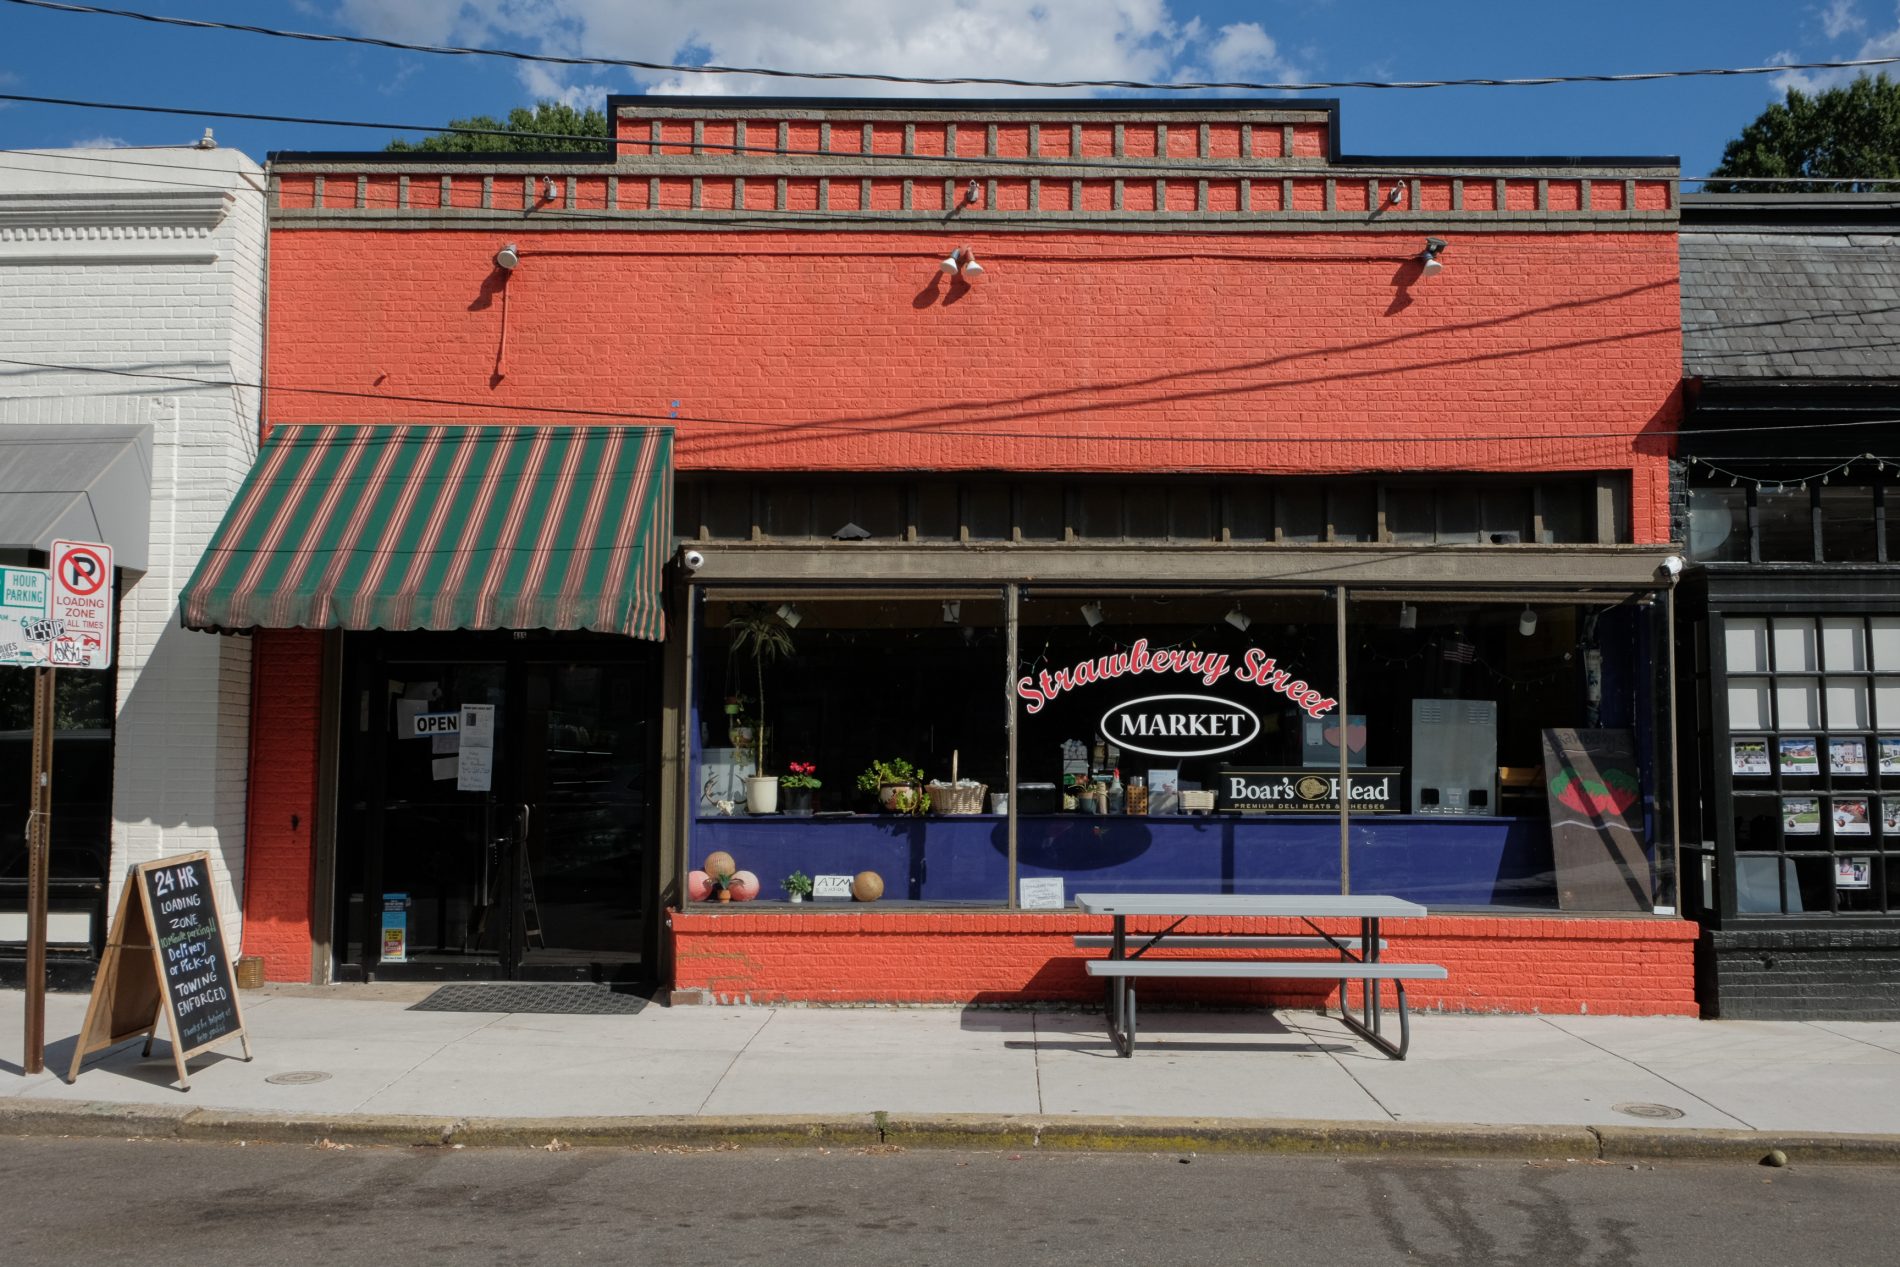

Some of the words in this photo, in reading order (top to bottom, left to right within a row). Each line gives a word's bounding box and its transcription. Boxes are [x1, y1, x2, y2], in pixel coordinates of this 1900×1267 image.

[13, 574, 37, 588] HOUR
[6, 588, 43, 603] PARKING
[56, 596, 105, 609] LOADING
[20, 615, 29, 628] 6
[65, 608, 96, 619] ZONE
[67, 619, 80, 628] ALL
[83, 620, 104, 629] TIMES
[1017, 638, 1230, 714] Strawberry
[1235, 648, 1338, 719] Street
[416, 715, 457, 732] OPEN
[1120, 713, 1246, 736] MARKET
[1229, 776, 1295, 800] Boar's
[1329, 776, 1390, 801] Head
[154, 868, 175, 897] 24
[176, 864, 199, 891] HR
[817, 877, 851, 887] ATM
[160, 893, 201, 915] LOADING
[168, 913, 199, 929] ZONE
[168, 940, 207, 962] Delivery
[169, 965, 179, 976] or
[180, 954, 216, 973] Pick-up
[174, 971, 217, 997] TOWING
[177, 986, 227, 1017] ENFORCED
